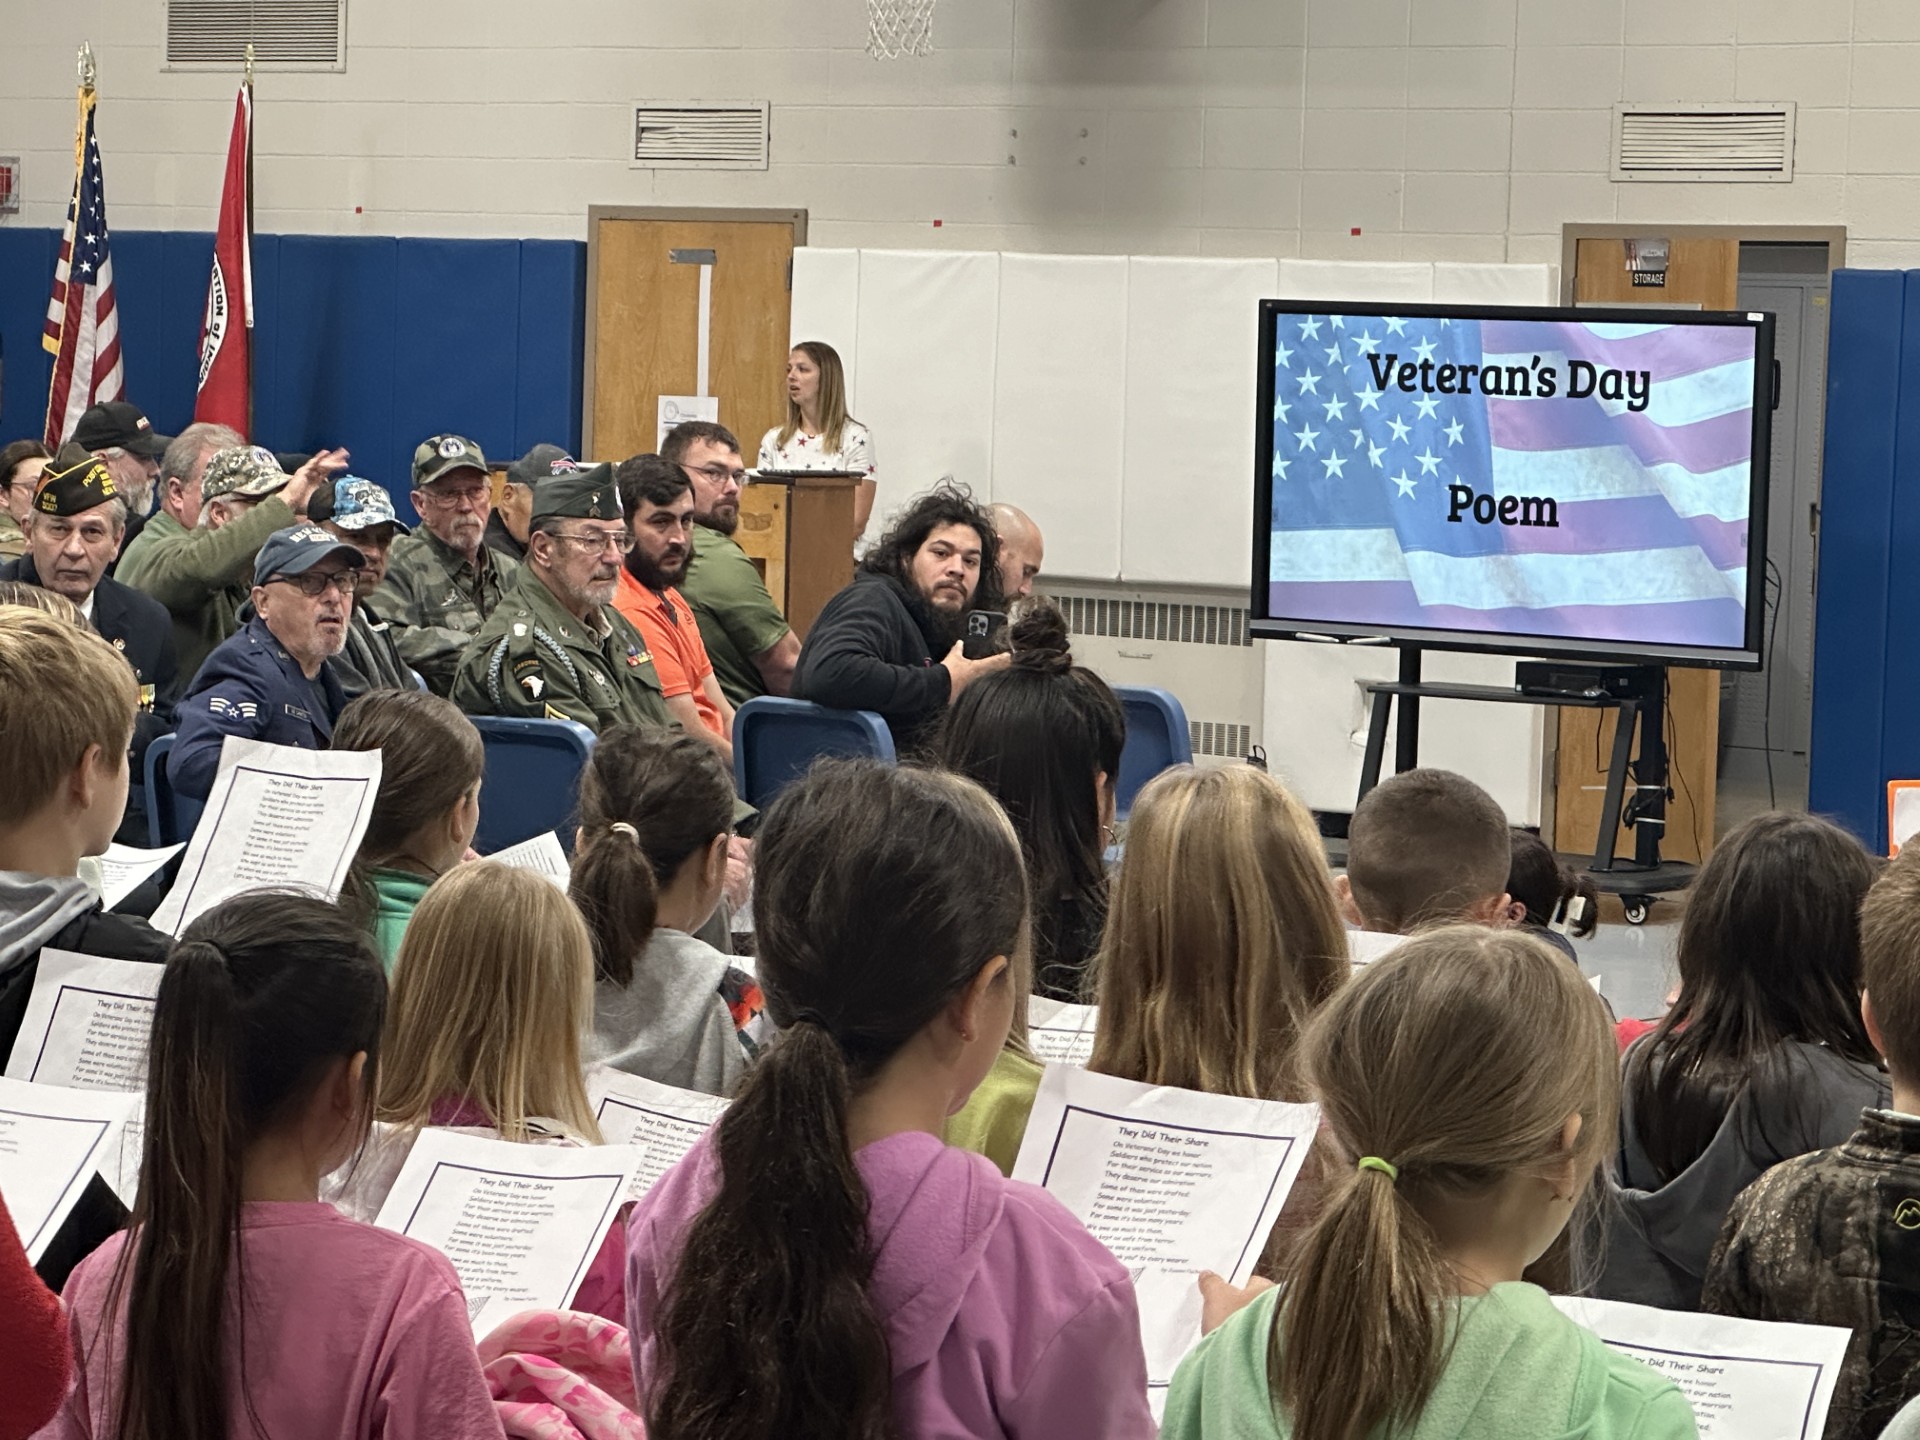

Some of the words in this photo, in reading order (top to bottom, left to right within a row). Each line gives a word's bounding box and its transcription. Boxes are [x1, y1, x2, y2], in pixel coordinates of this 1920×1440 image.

[1634, 273, 1664, 284] STORAGE
[211, 323, 220, 340] of
[1367, 353, 1556, 398] Veteran's
[1566, 360, 1650, 412] Day
[1447, 484, 1559, 528] Poem
[269, 779, 281, 787] They
[98, 999, 112, 1009] They
[641, 1116, 655, 1126] They
[1119, 1127, 1138, 1138] They
[1141, 1130, 1156, 1140] Did
[1160, 1132, 1182, 1144] Their
[1184, 1137, 1209, 1147] Share
[1110, 1150, 1138, 1160] Soldiers
[1157, 1147, 1170, 1156] Day
[1107, 1160, 1119, 1168] For
[1105, 1170, 1120, 1180] They
[1122, 1174, 1148, 1183] deserve
[480, 1177, 496, 1187] They
[513, 1181, 532, 1190] Their
[1101, 1183, 1118, 1191] Some
[1097, 1192, 1114, 1201] Some
[1648, 1358, 1665, 1367] Did
[1668, 1360, 1693, 1370] Their
[1697, 1364, 1724, 1374] Share
[1696, 1379, 1717, 1387] honor
